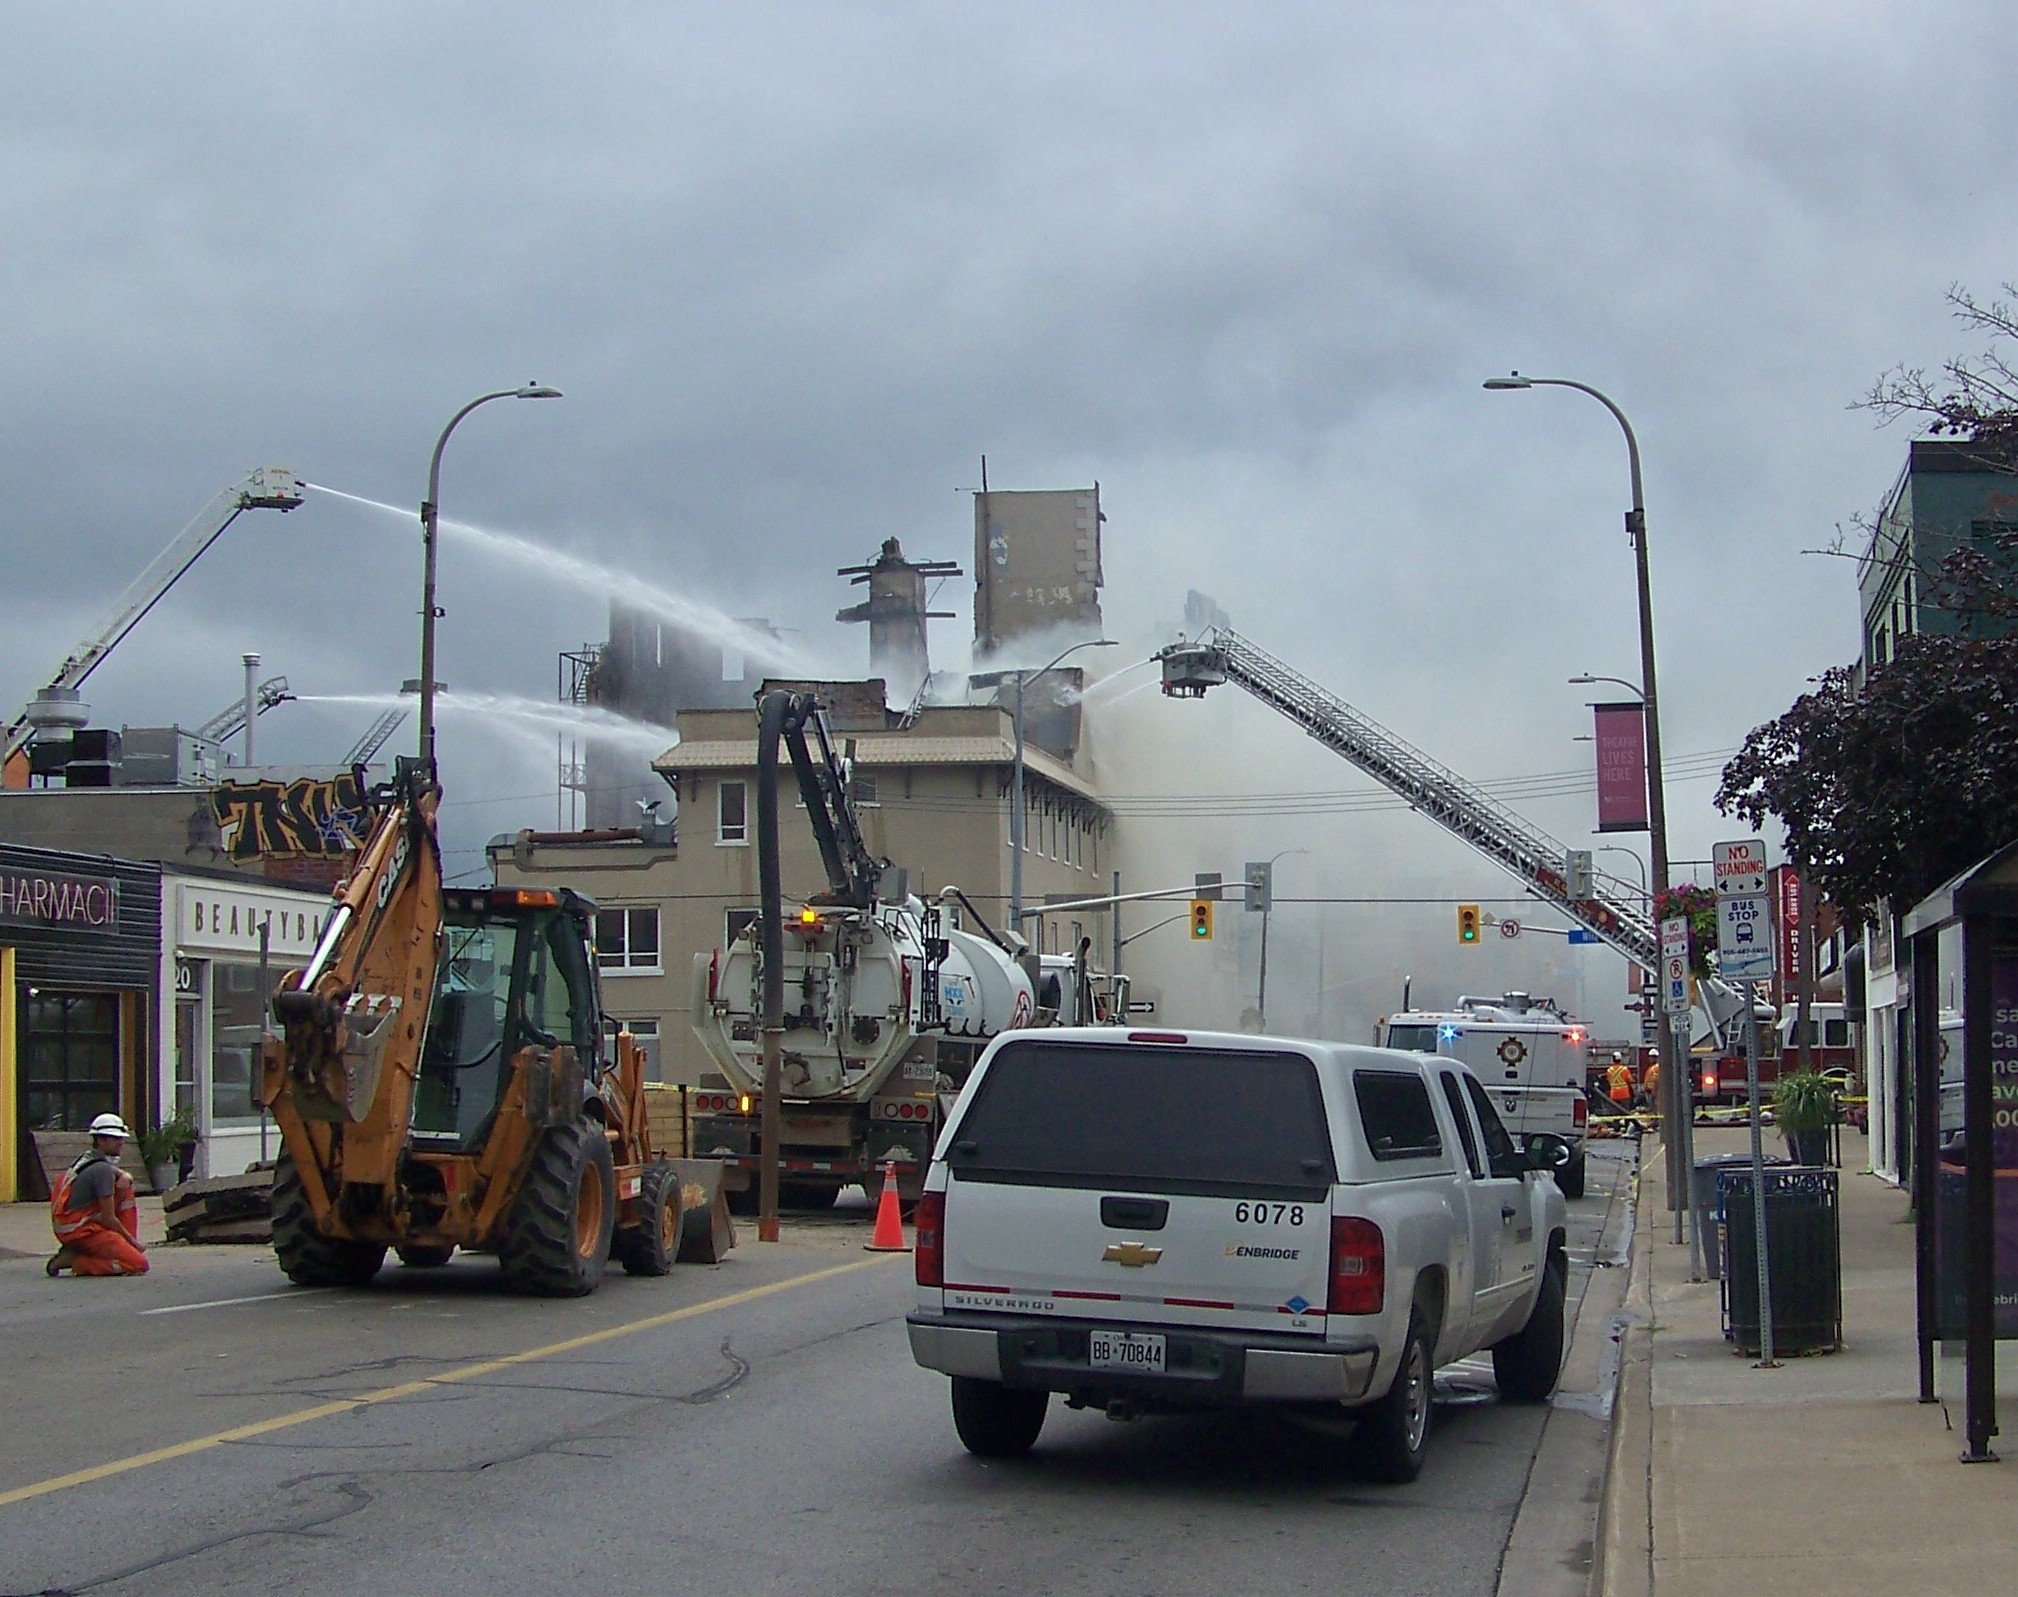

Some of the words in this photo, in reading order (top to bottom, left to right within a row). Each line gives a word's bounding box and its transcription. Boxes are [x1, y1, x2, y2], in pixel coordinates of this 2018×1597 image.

[1602, 737, 1639, 748] THEATRE
[1602, 750, 1635, 765] LIVES
[1603, 767, 1632, 781] HERE
[1728, 845, 1749, 860] NO
[378, 833, 411, 908] CAS
[1717, 860, 1764, 877] STANDING
[1731, 901, 1755, 911] BUS
[1728, 911, 1759, 921] STOP
[1668, 922, 1680, 933] NO
[1235, 1202, 1304, 1226] 6078
[1236, 1246, 1300, 1260] ENBRIDGE
[955, 1295, 1054, 1310] SILVERADO
[1093, 1341, 1110, 1360] BB
[1118, 1342, 1161, 1364] 70844
